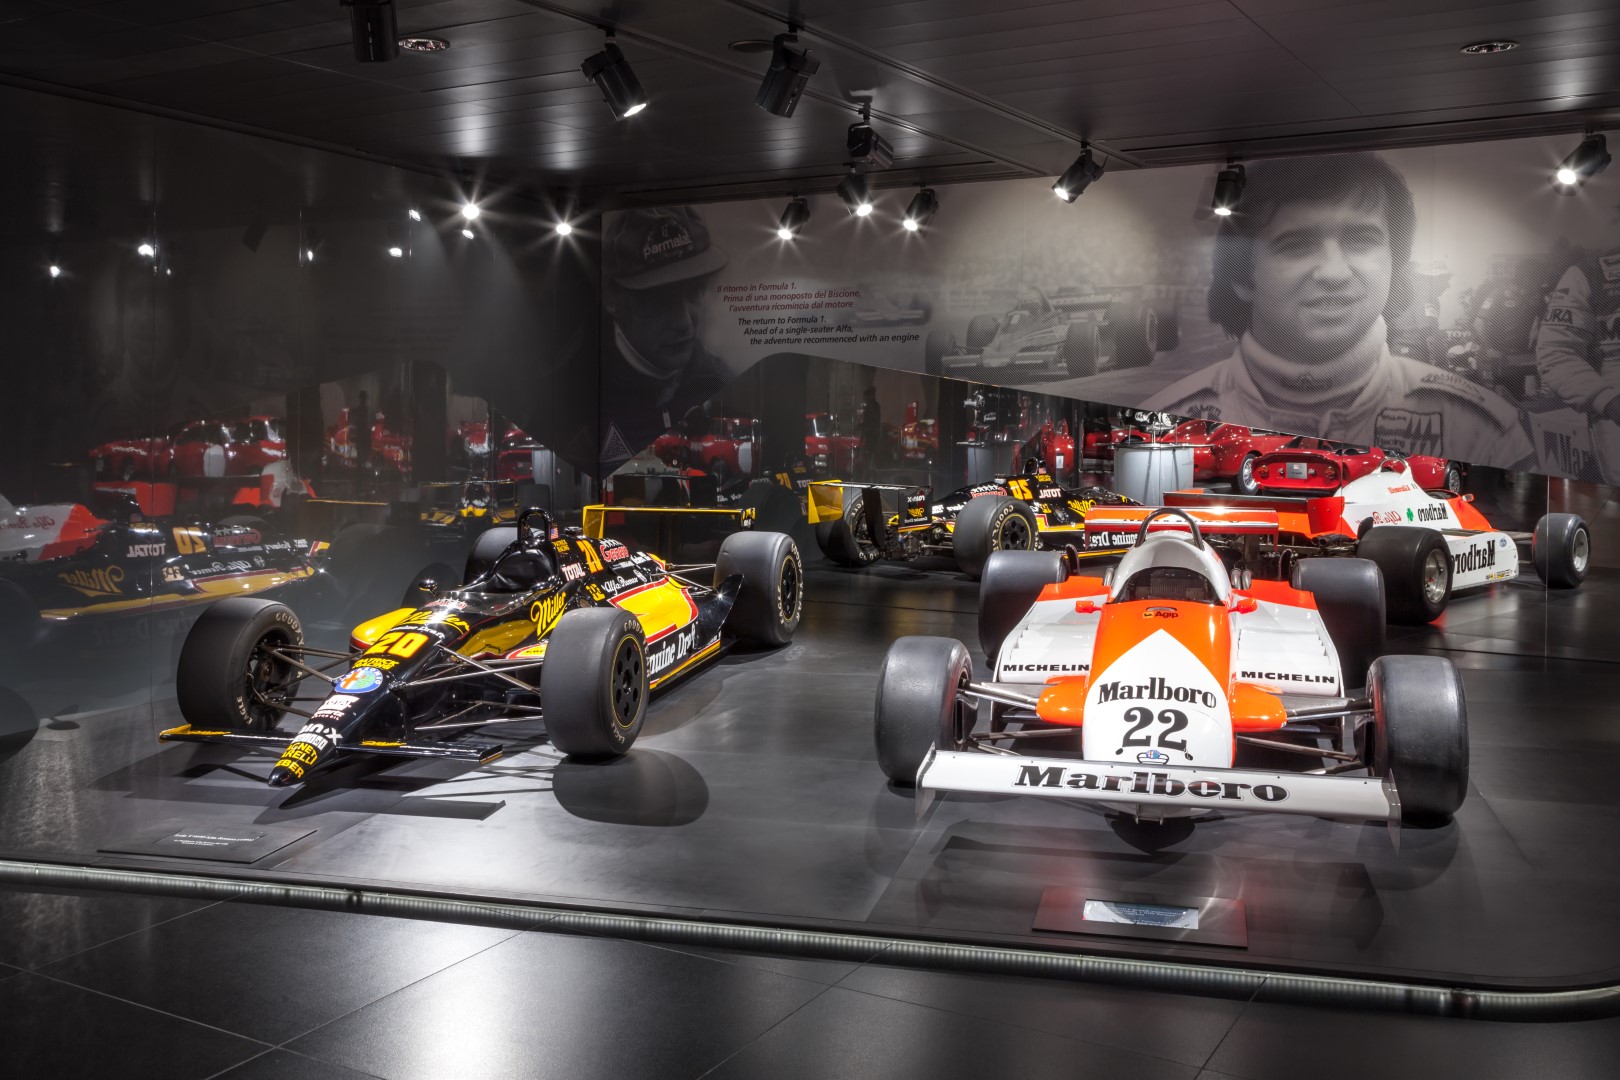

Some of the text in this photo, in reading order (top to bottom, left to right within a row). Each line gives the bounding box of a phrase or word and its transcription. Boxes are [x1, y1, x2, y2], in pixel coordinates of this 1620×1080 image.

[642, 232, 693, 260] parmalat
[723, 284, 748, 292] ritorno
[749, 284, 757, 292] in
[758, 282, 788, 291] Formula
[791, 282, 797, 290] 1.
[723, 294, 744, 302] Prima
[745, 293, 753, 301] di
[769, 292, 812, 301] monoposto
[814, 290, 826, 299] del
[828, 290, 861, 299] Biscione,
[729, 301, 854, 312] l'avventura ricomincia dal motore
[738, 315, 827, 326] The return to Formula 1.
[743, 327, 768, 335] Ahead
[769, 326, 778, 335] of
[785, 325, 833, 335] single-seater
[835, 324, 854, 333] Alfa,
[750, 337, 762, 345] the
[763, 336, 801, 345] adventure
[803, 335, 857, 344] recommenced
[859, 333, 876, 342] with
[891, 333, 920, 343] engine
[562, 562, 586, 582] TOTAL
[530, 591, 567, 637] Miller
[1155, 610, 1179, 619] Agip
[362, 631, 429, 659] 20
[648, 640, 676, 675] nuine
[1002, 662, 1090, 673] MICHELIN
[1240, 670, 1335, 684] MICHELIN
[1096, 676, 1217, 709] Marlboro
[1121, 706, 1189, 752] 22
[274, 759, 305, 779] EBER
[1014, 764, 1291, 803] Marlboro
